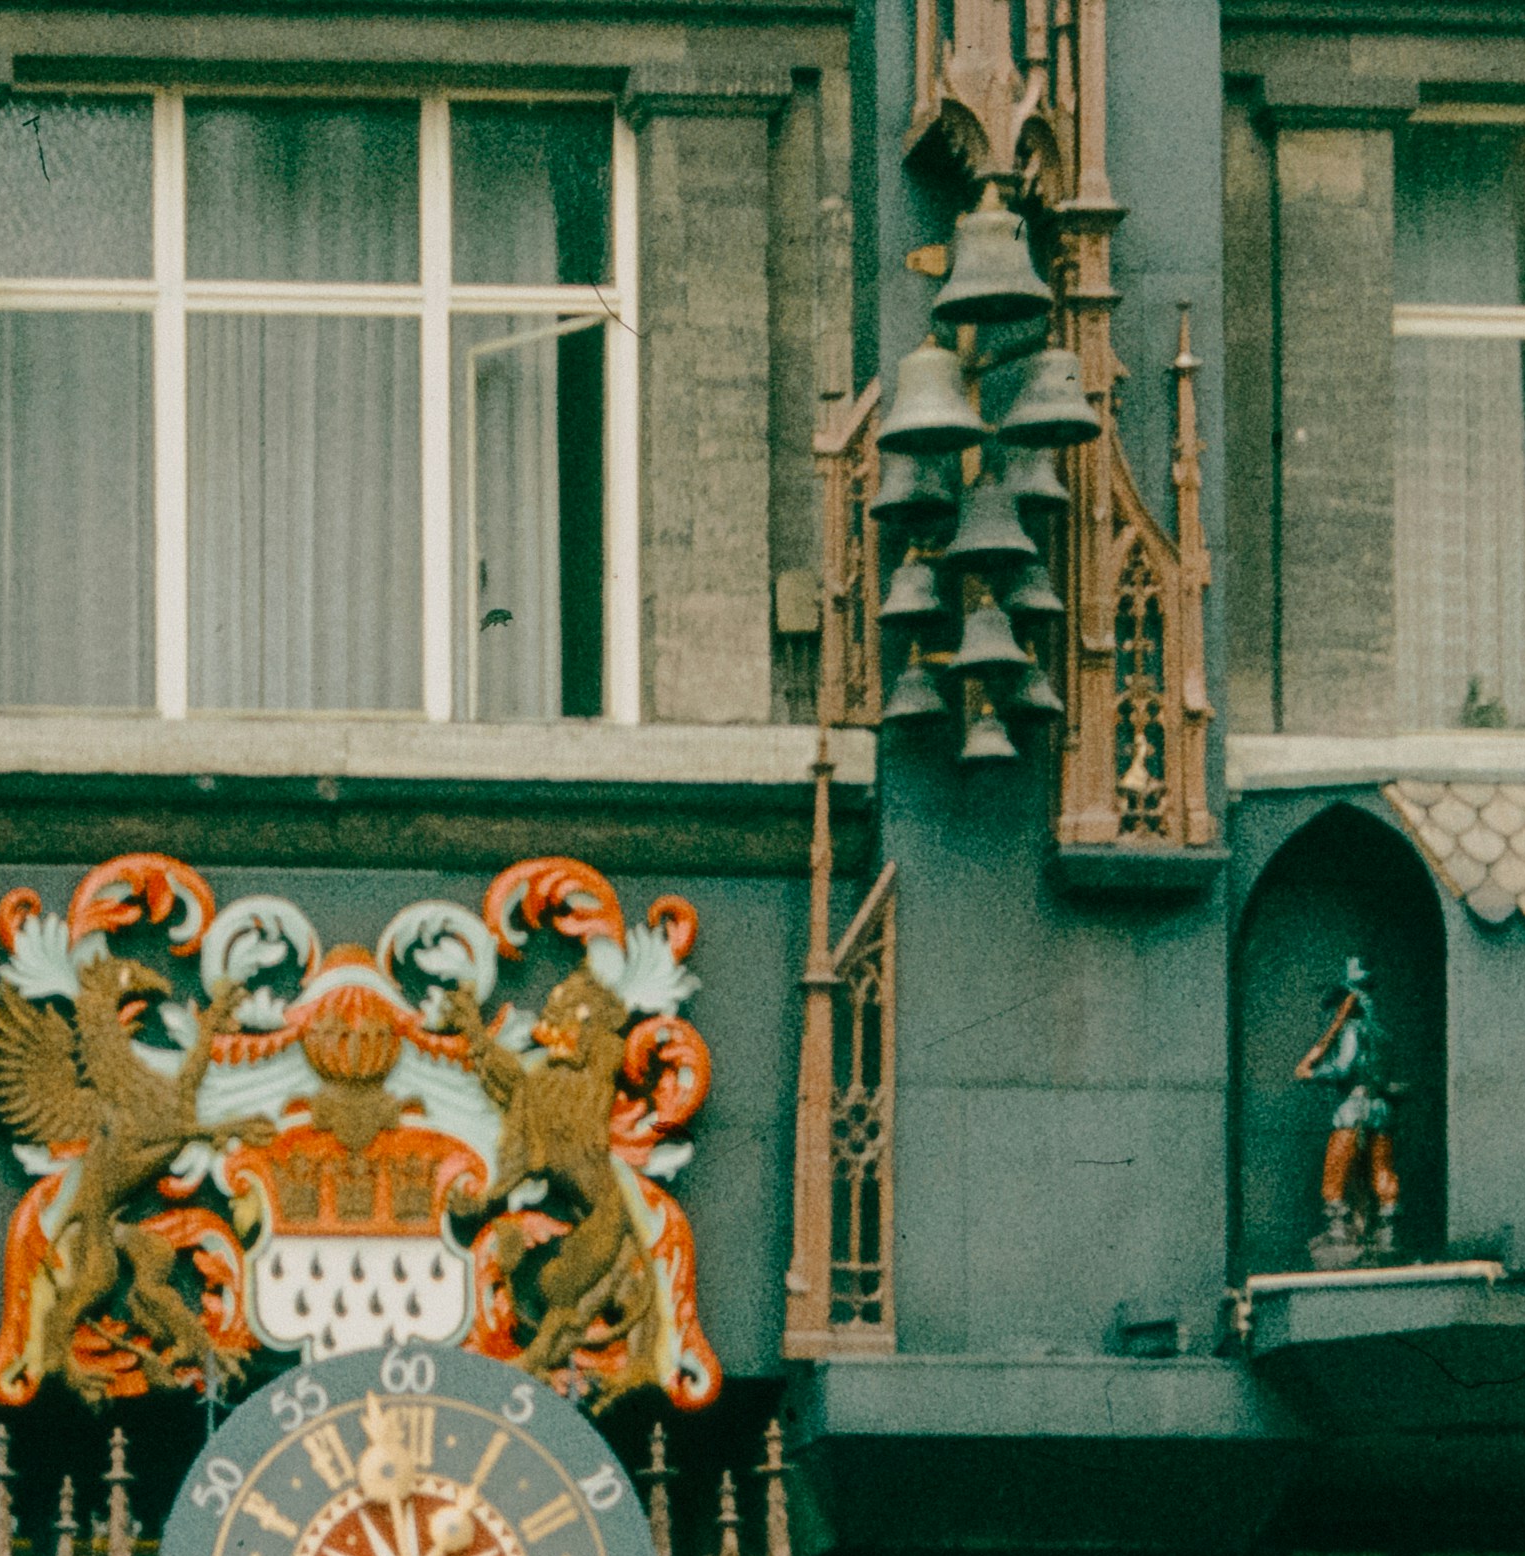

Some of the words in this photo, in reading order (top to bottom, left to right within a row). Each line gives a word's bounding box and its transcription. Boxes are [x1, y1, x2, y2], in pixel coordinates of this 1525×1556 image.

[380, 1349, 436, 1394] 60
[271, 1375, 329, 1431] 55
[501, 1384, 535, 1424] 5
[302, 1423, 355, 1490] XI
[191, 1457, 244, 1516] 50
[579, 1464, 623, 1510] 10
[241, 1490, 300, 1539] X
[521, 1492, 578, 1544] II
